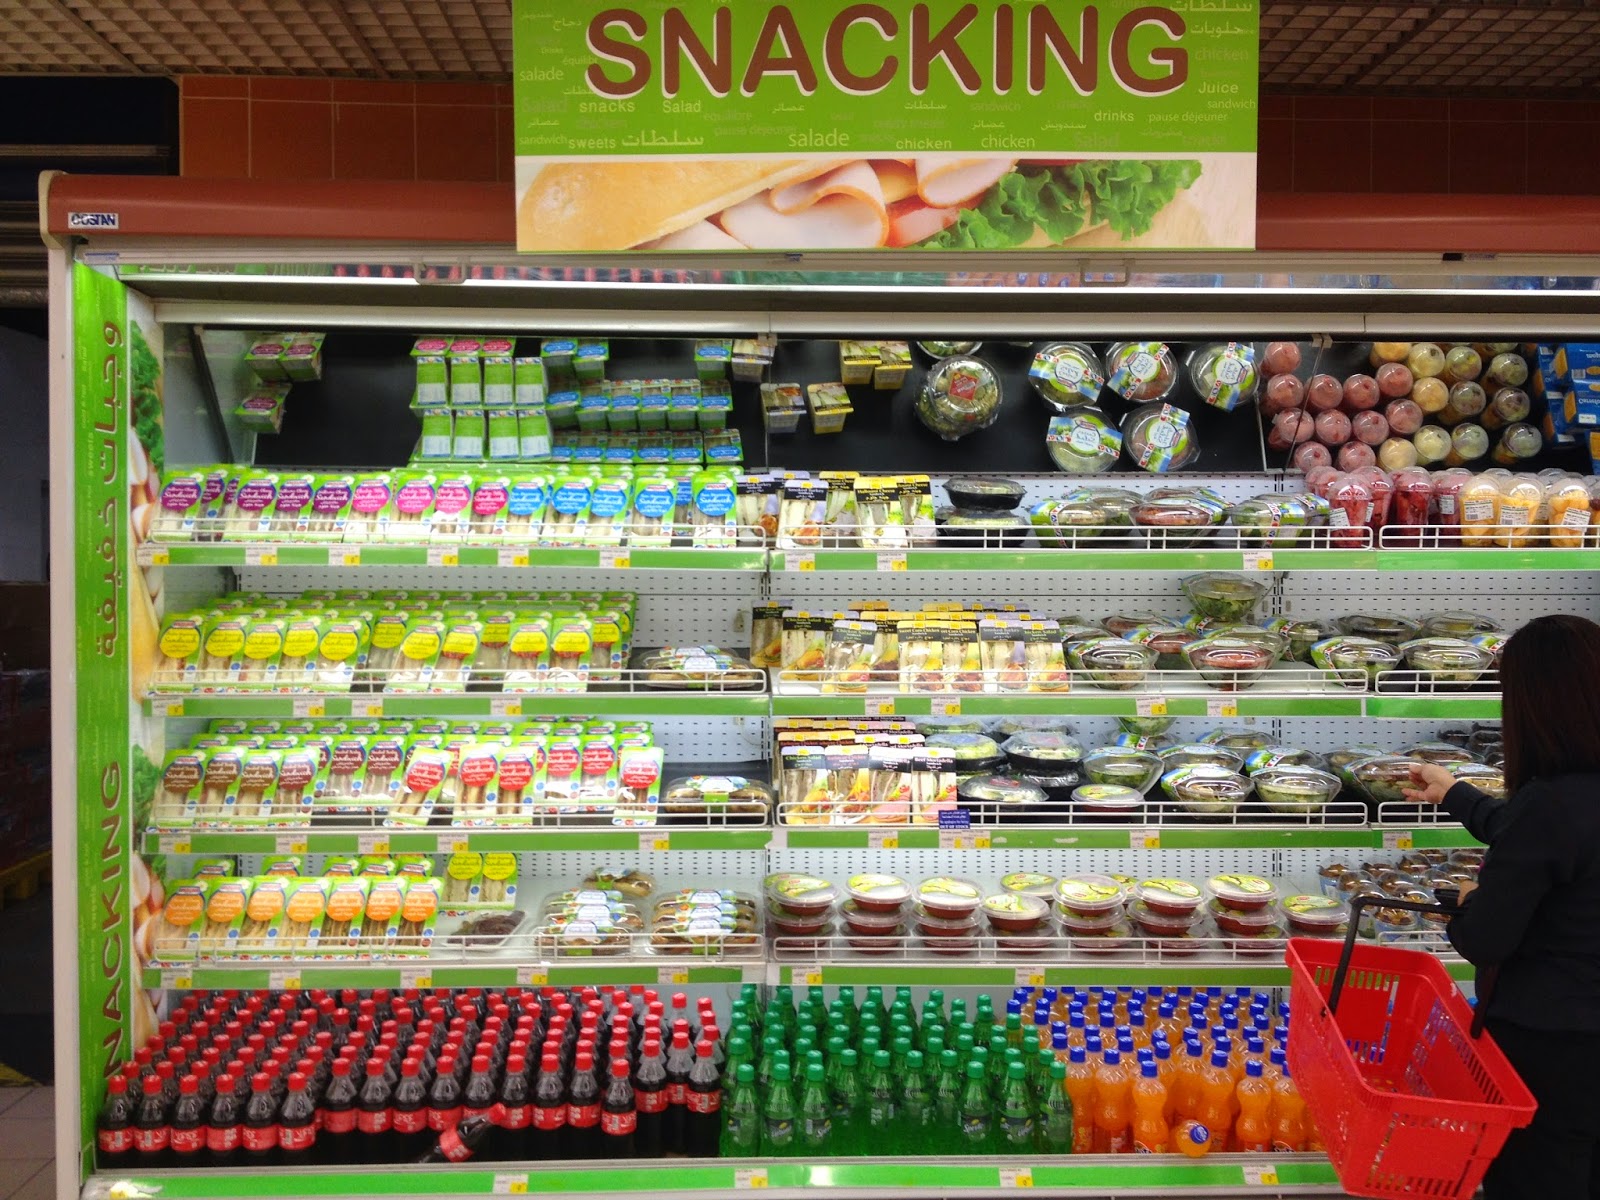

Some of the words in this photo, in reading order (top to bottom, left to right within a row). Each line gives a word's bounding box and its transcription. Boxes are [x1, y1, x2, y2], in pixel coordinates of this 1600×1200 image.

[585, 3, 1189, 98] SNACKING
[562, 55, 598, 66] équilibr
[519, 67, 564, 81] salade
[1198, 82, 1239, 94] Juice
[578, 100, 636, 113] snacks
[662, 100, 701, 113] Salad
[1207, 98, 1256, 109] sandwich
[1094, 110, 1134, 122] drinks
[1149, 112, 1179, 124] pause
[1181, 111, 1228, 124] déjeuner
[519, 133, 567, 145] sandwich
[568, 136, 616, 150] sweets
[621, 129, 705, 147] سلطات
[788, 128, 849, 147] salade
[895, 137, 952, 150] chicken
[981, 133, 1036, 149] chicken
[70, 213, 116, 226] COSTAN
[101, 761, 123, 1078] NACKING
